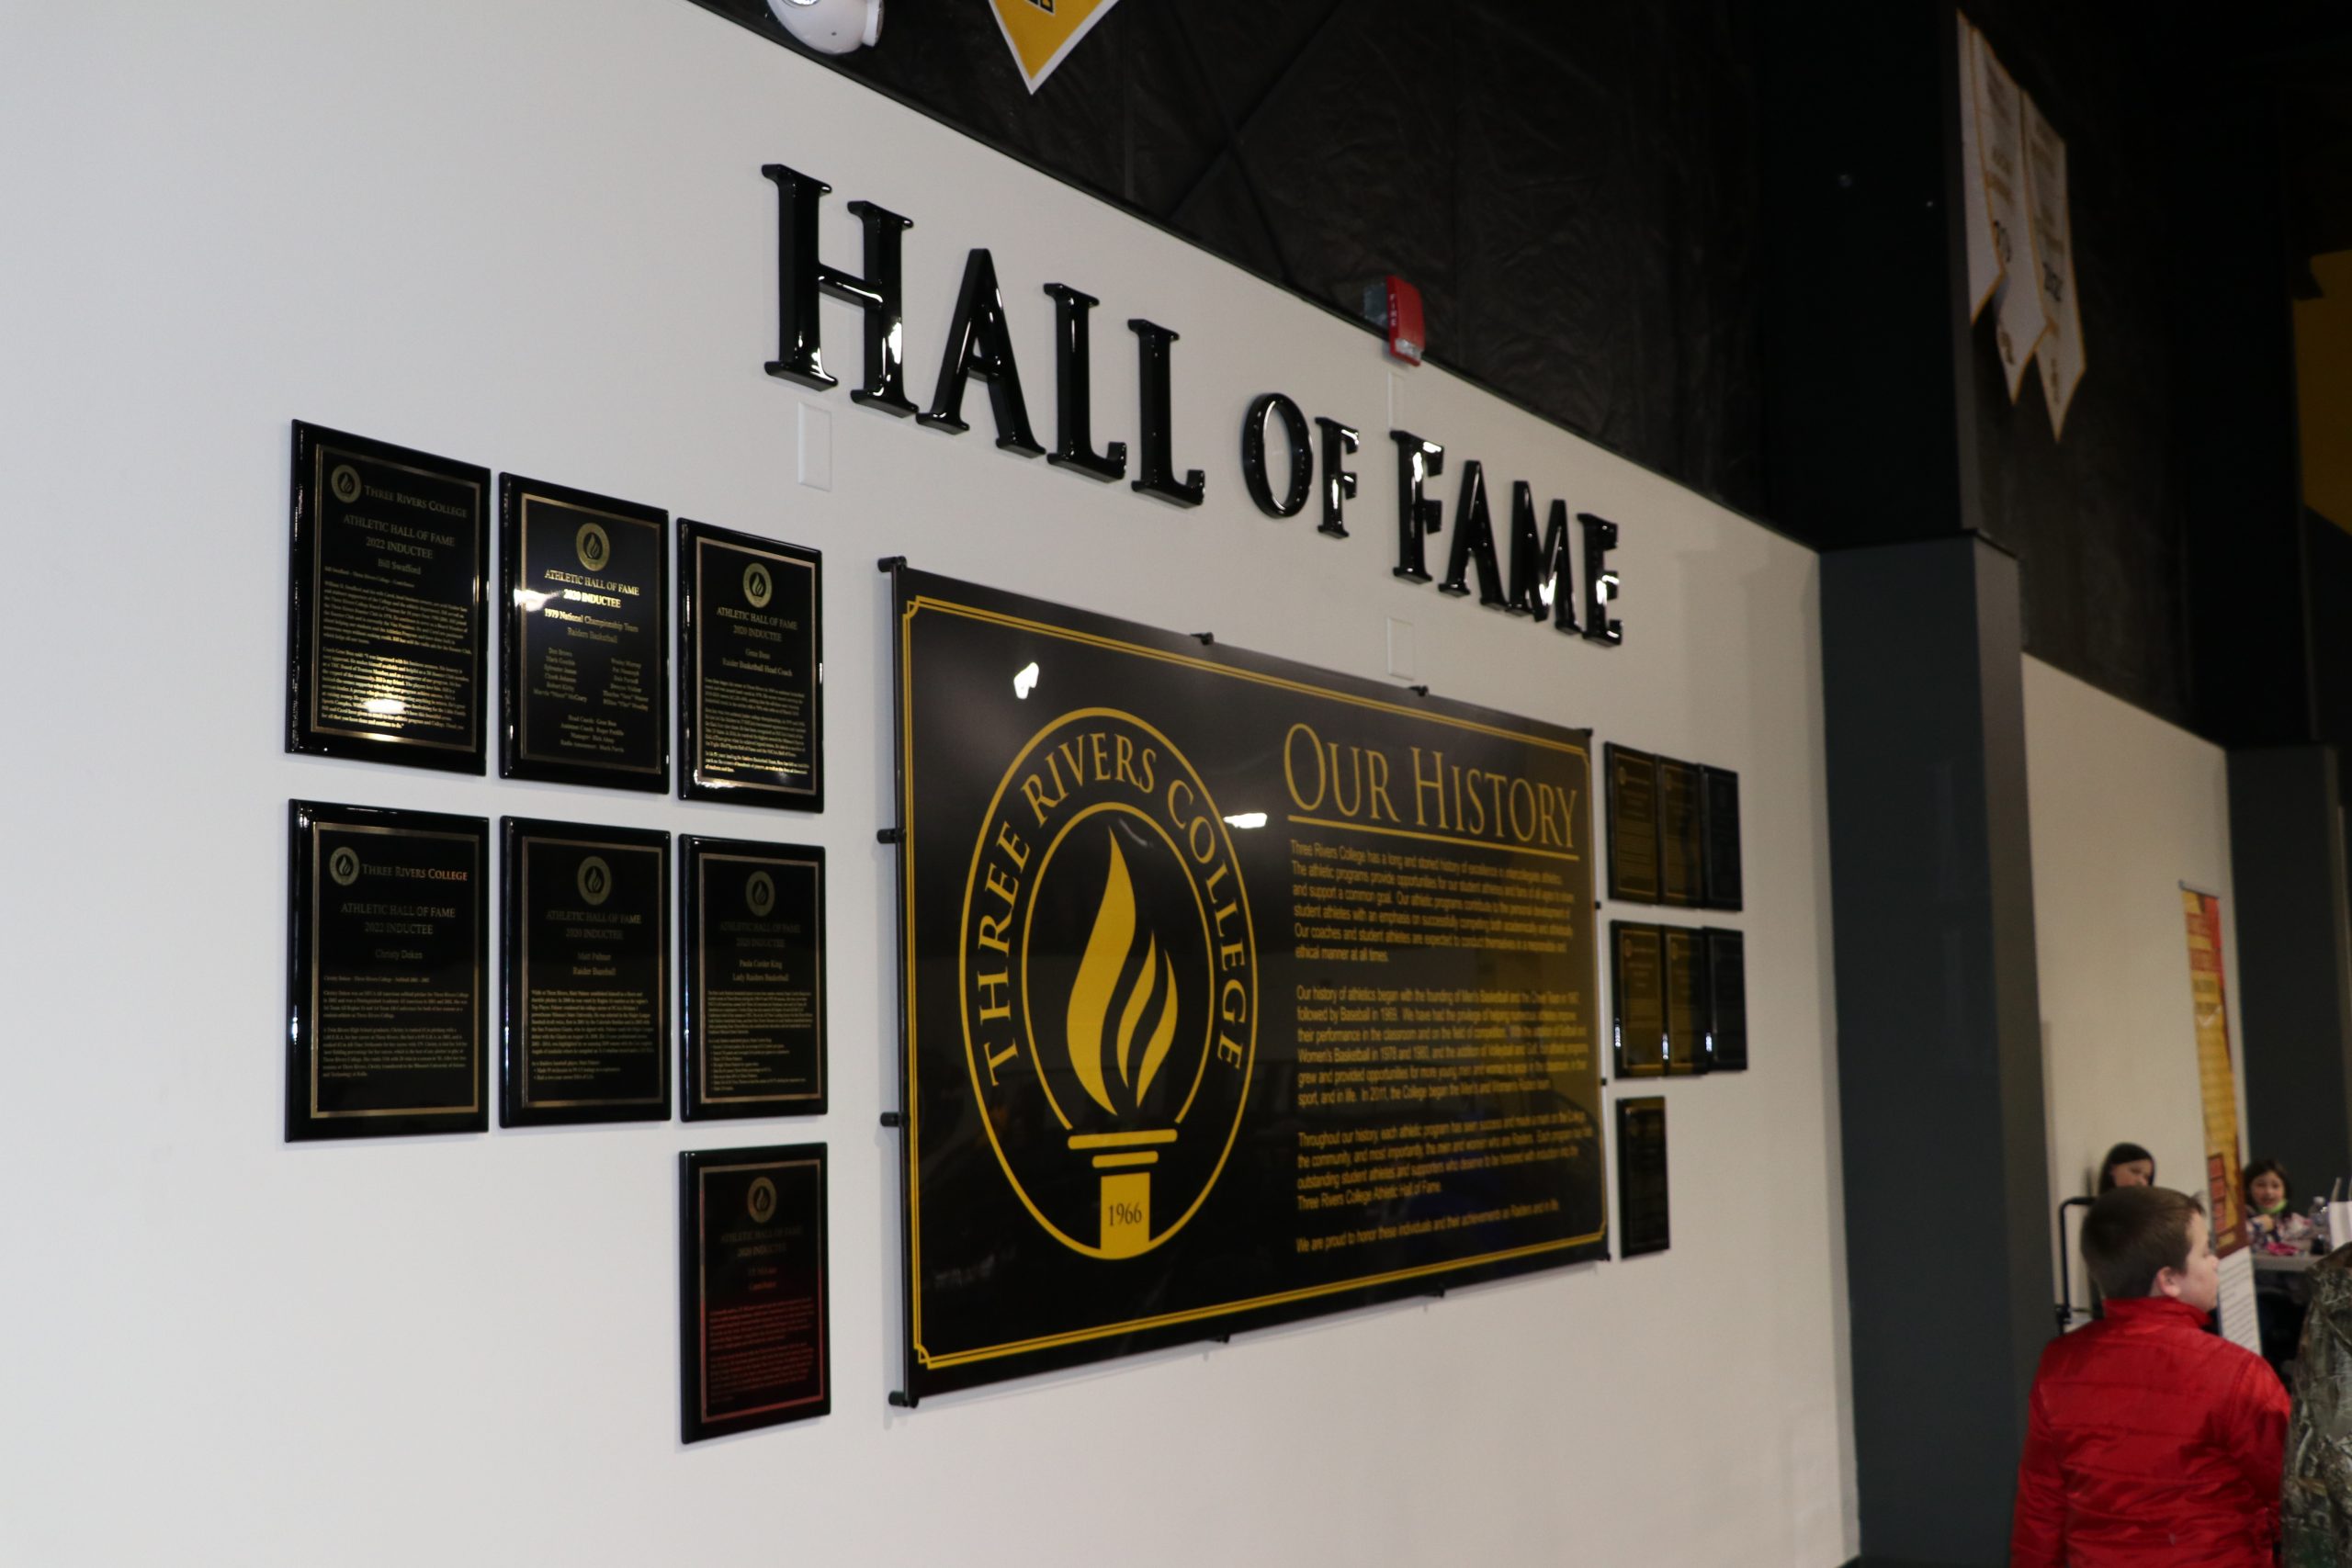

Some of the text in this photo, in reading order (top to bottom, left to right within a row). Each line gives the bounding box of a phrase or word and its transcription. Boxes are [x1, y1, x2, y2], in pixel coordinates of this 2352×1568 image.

[762, 164, 1623, 647] HALL OF FAME
[397, 492, 425, 509] RIVERS
[428, 500, 466, 518] COLLEGE
[344, 513, 454, 546] ATHLETIC HALL OF FAME
[366, 536, 433, 558] 2022 INDUCTEE
[378, 558, 390, 569] Bill
[544, 569, 639, 595] ATHLETIC HALL OF FAME
[582, 592, 620, 608] INDUCTEE
[560, 611, 582, 623] National
[584, 615, 622, 631] Championship
[623, 621, 638, 632] Team
[717, 606, 797, 629] ATHLETIC HALL OF FAME
[748, 627, 781, 641] INDUCTEE
[1283, 723, 1401, 822] OUR
[1410, 746, 1577, 849] HISTORY
[1291, 840, 1312, 856] Three
[1314, 843, 1337, 859] Rivers
[1339, 847, 1364, 864] College
[1367, 851, 1379, 863] has
[395, 866, 425, 878] RIVERS
[428, 868, 468, 881] COLLEGE
[1292, 861, 1306, 875] The
[1308, 863, 1333, 878] athletic
[1336, 868, 1368, 885] programs
[1370, 870, 1394, 886] provide
[1293, 884, 1306, 896] and
[1309, 886, 1336, 901] support
[1345, 891, 1374, 901] common
[341, 902, 455, 918] ATHLETIC HALL OF FAME
[546, 910, 640, 923] ATHLETIC HALL OF FAME
[978, 732, 1248, 1086] THREE RIVERS COLLEGE
[1294, 904, 1319, 918] student
[1323, 907, 1350, 919] athletes
[386, 922, 433, 934] INDUCTEE
[1295, 924, 1307, 937] Our
[1311, 925, 1340, 939] coaches
[1343, 928, 1356, 940] and
[1359, 929, 1383, 942] student
[1295, 946, 1318, 958] ethical
[1321, 949, 1348, 959] manner
[1296, 986, 1310, 999] Our
[1313, 986, 1336, 1002] history
[1340, 987, 1345, 999] of
[1348, 987, 1374, 1000] athletics
[1297, 1006, 1327, 1021] followed
[1329, 1007, 1337, 1023] by
[1340, 1007, 1369, 1021] Baseball
[1297, 1028, 1313, 1042] their
[1316, 1028, 1360, 1043] performance
[1297, 1049, 1331, 1063] Women's
[1335, 1048, 1369, 1061] Basketball
[1298, 1073, 1316, 1086] grew
[1318, 1070, 1331, 1082] and
[1335, 1069, 1364, 1084] provided
[1320, 1089, 1334, 1103] and
[1297, 1130, 1339, 1150] Throughout
[1341, 1131, 1351, 1143] our
[1297, 1154, 1309, 1168] the
[1354, 1148, 1366, 1162] and
[1297, 1172, 1339, 1192] outstanding
[1341, 1168, 1366, 1184] student
[1297, 1194, 1317, 1211] Three
[1320, 1191, 1343, 1207] Rivers
[1346, 1188, 1371, 1207] College
[1109, 1201, 1142, 1226] 1966
[1296, 1237, 1308, 1252] We
[1311, 1237, 1322, 1250] are
[1325, 1232, 1346, 1250] proud
[1357, 1227, 1375, 1243] honor
